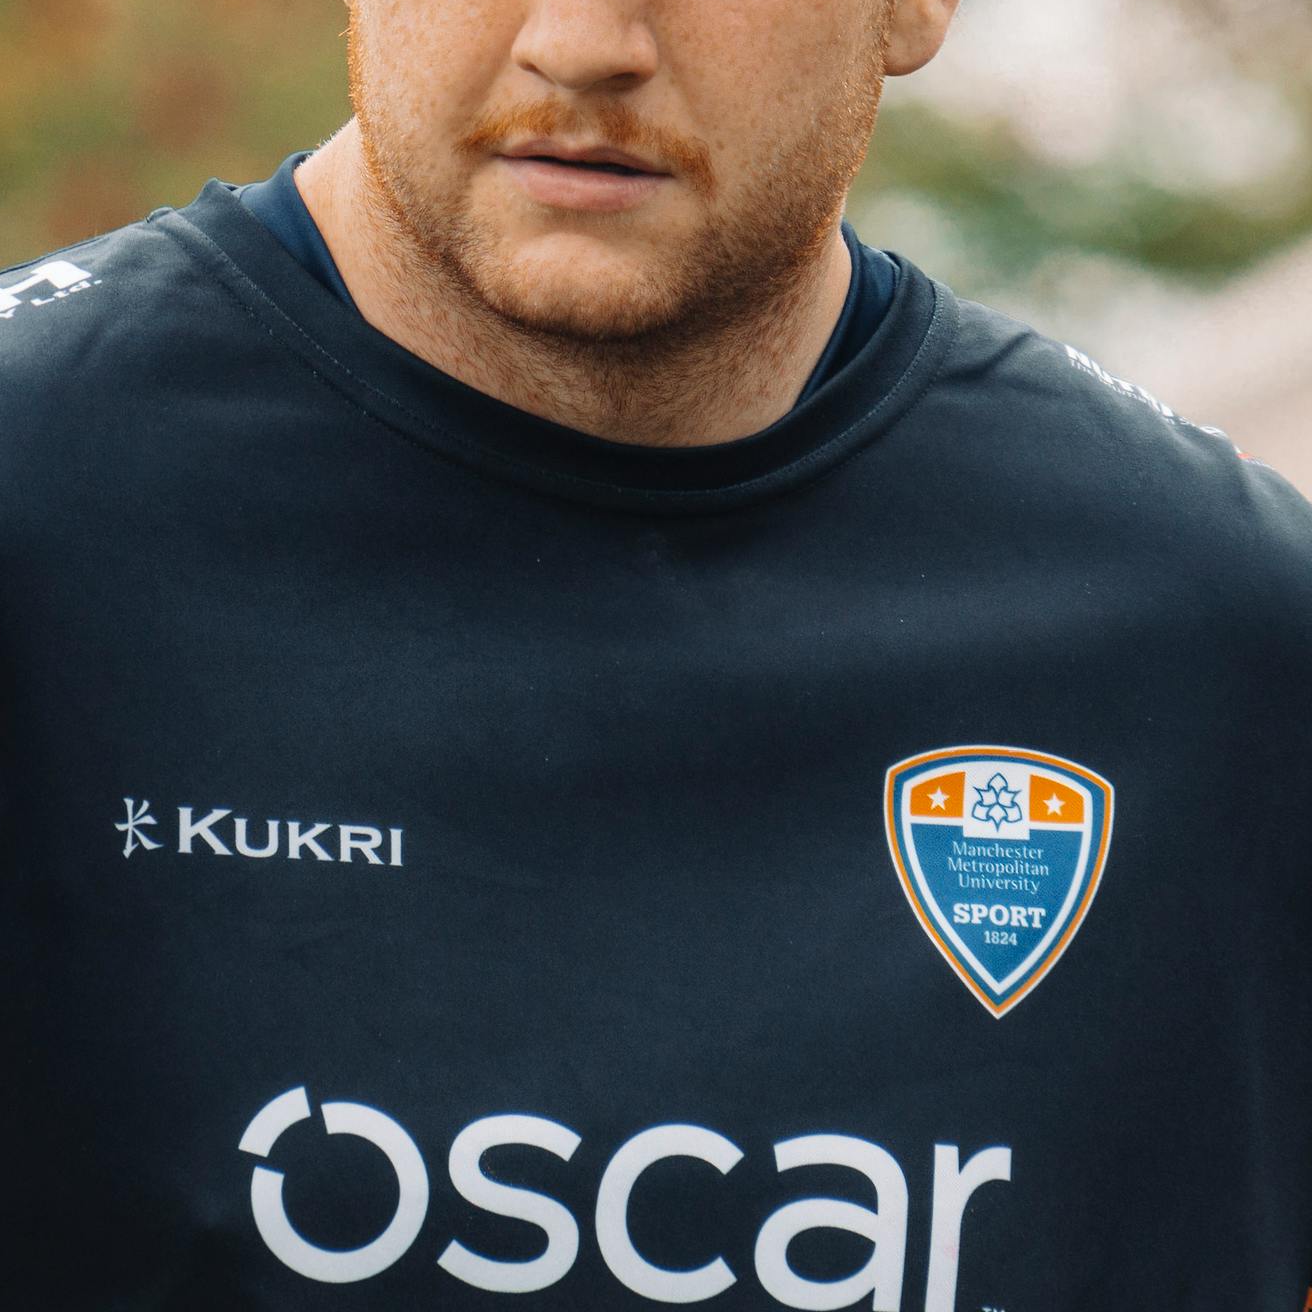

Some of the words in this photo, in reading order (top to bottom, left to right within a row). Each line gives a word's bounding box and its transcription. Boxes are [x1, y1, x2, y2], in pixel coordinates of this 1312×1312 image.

[178, 807, 403, 866] KUKRI
[952, 841, 1044, 859] Manchester
[948, 856, 1049, 876] Metropolitan
[959, 873, 1040, 895] University
[953, 903, 1046, 928] SPORT
[984, 931, 1017, 945] 1824
